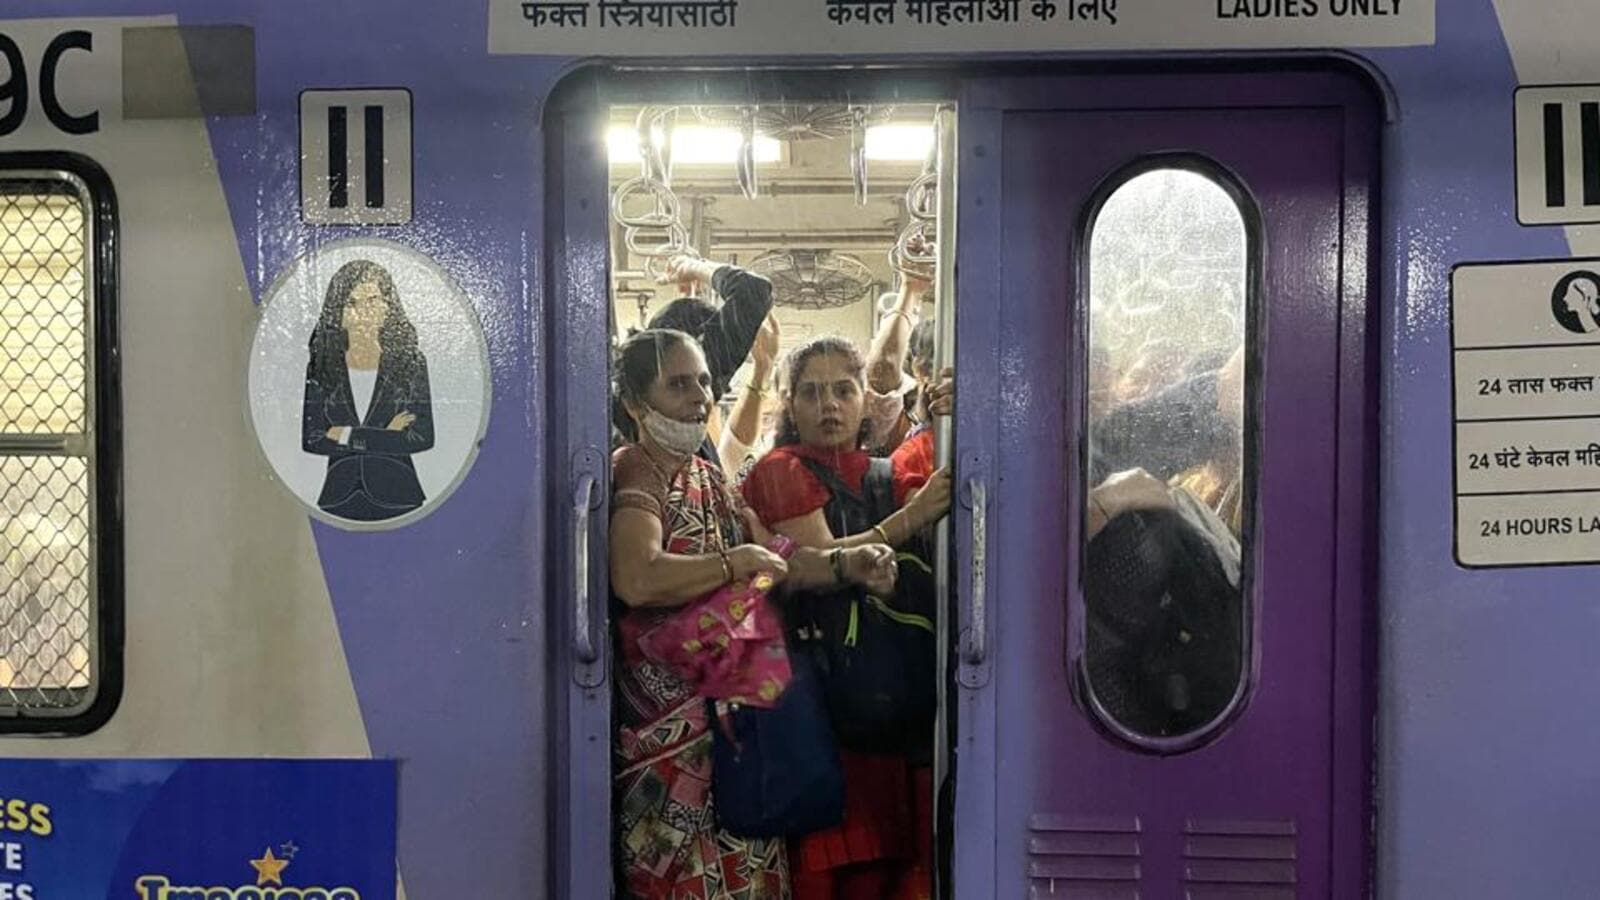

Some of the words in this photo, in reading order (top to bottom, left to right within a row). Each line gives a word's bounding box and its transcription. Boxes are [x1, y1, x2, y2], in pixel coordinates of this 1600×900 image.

[522, 2, 589, 27] फक्त
[1216, 0, 1319, 18] LADIES
[1329, 0, 1402, 16] ONLY
[1479, 379, 1501, 395] 24
[1508, 377, 1544, 394] तास
[1551, 376, 1594, 392] फक्त
[1469, 454, 1490, 469] 24
[1495, 446, 1521, 468] घंटे
[1527, 446, 1569, 467] केवल
[1481, 521, 1500, 537] 24
[1506, 518, 1573, 535] HOURS
